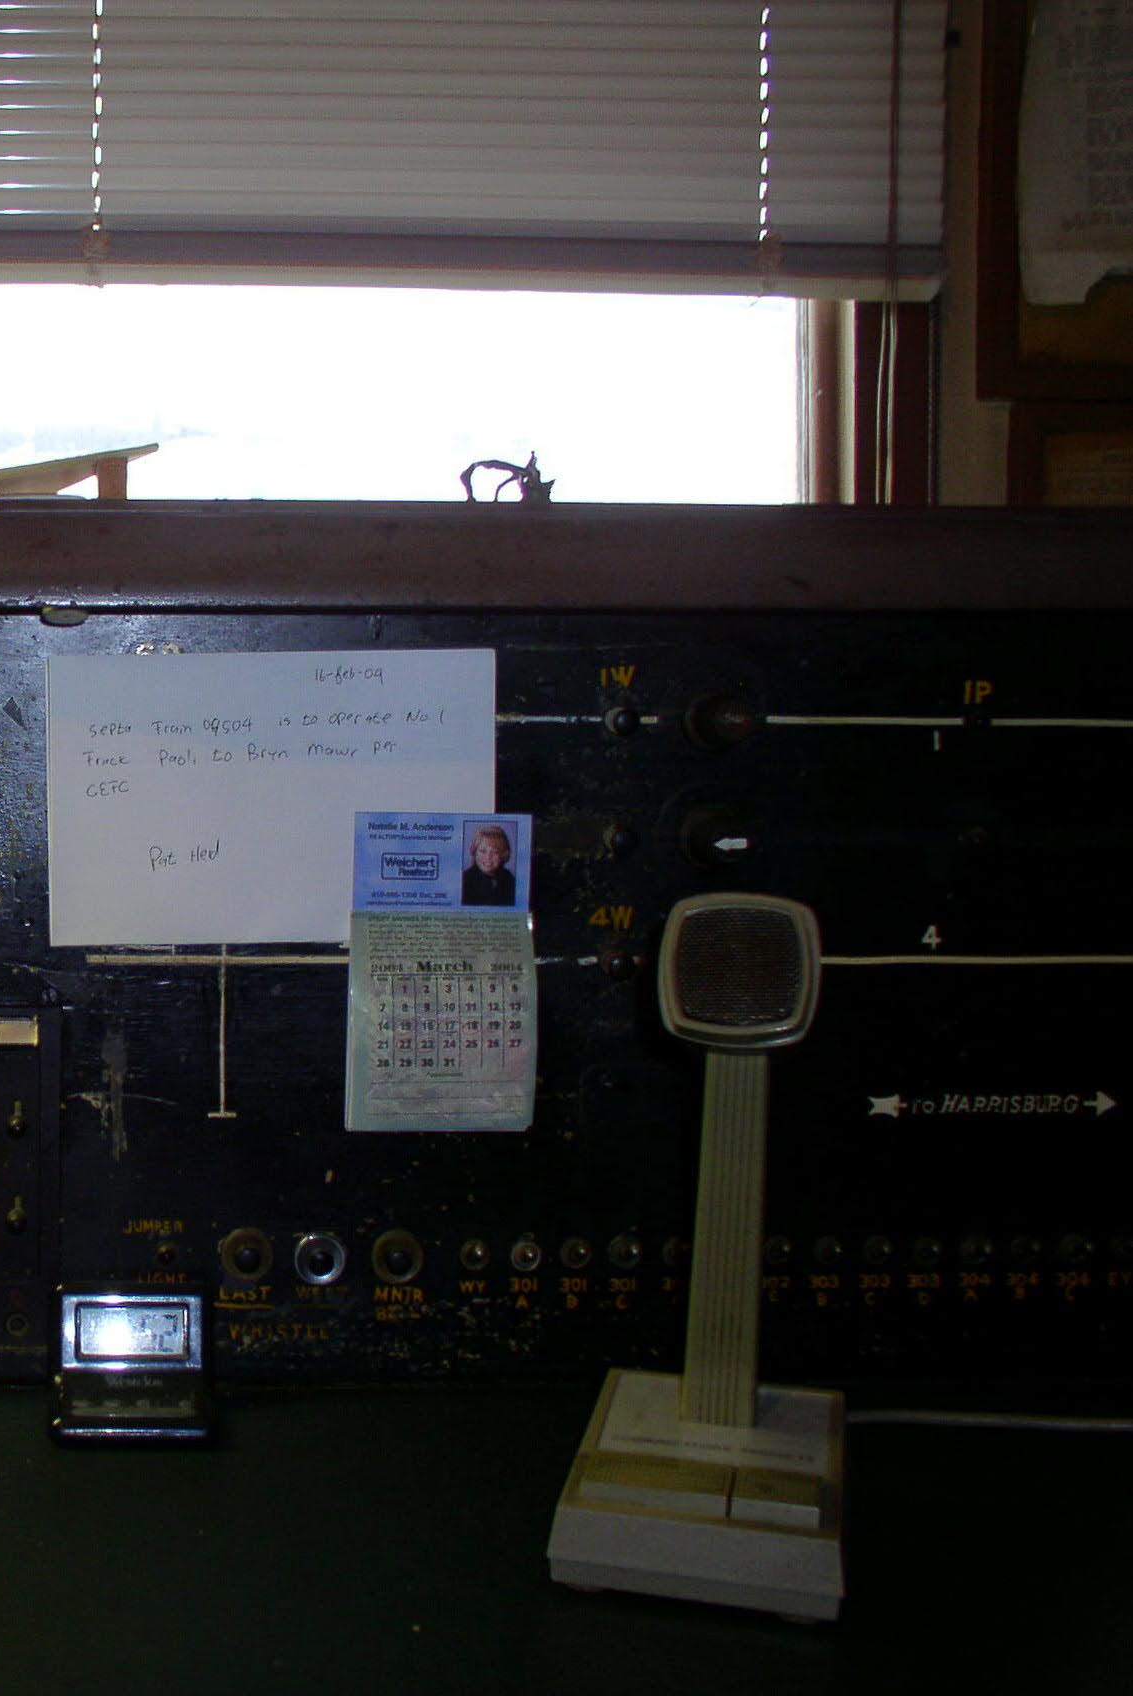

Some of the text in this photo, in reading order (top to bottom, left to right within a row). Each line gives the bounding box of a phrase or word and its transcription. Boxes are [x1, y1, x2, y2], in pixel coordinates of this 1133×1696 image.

[412, 823, 455, 832] Anderson
[586, 905, 635, 929] 4W
[921, 924, 942, 949] 4
[416, 960, 474, 973] March
[939, 1094, 1079, 1114] HARRISBURG
[122, 1219, 185, 1236] JUMPER
[508, 1276, 540, 1295] 301
[561, 1276, 588, 1294] 301
[610, 1276, 637, 1294] 301
